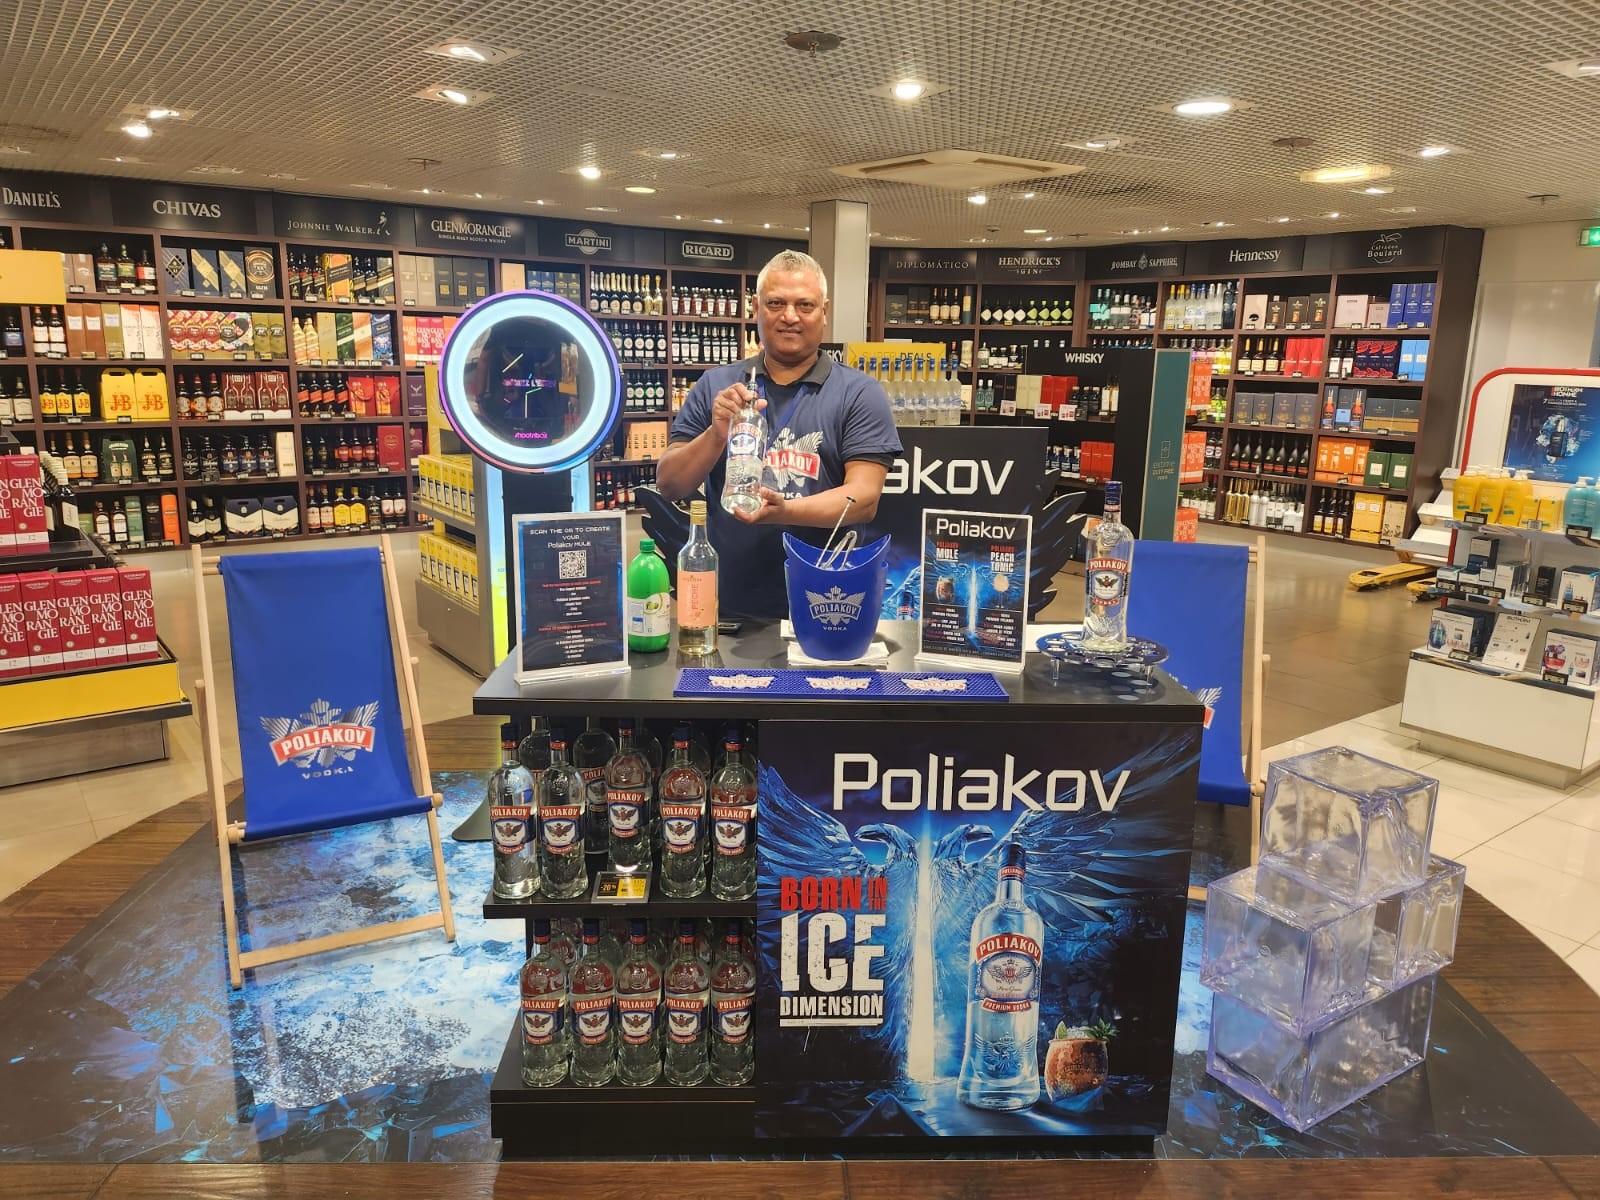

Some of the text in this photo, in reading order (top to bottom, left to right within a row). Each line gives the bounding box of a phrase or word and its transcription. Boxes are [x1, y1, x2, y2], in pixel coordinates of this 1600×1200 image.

[153, 200, 221, 218] CHIVAS
[287, 219, 331, 231] JOHNNIE
[431, 219, 512, 238] GLENMORANGIE
[567, 236, 611, 249] MARTINI
[685, 243, 731, 258] RICARD
[1229, 248, 1281, 263] Hennessy
[1367, 248, 1402, 257] Boulard
[896, 259, 969, 269] DIPLOMÁTICO
[998, 257, 1061, 266] HENDRICK'S
[1111, 260, 1137, 270] BOMBAY
[1065, 353, 1105, 364] WHISKY
[767, 451, 814, 472] LIAKOV
[881, 445, 1015, 495] akov
[10, 477, 41, 488] GLEN
[22, 487, 43, 498] MO
[12, 498, 37, 508] RAN
[23, 507, 44, 517] GIE
[936, 518, 1016, 540] Poliakov
[936, 547, 959, 560] MULE
[991, 551, 1014, 562] PEACH
[991, 561, 1014, 573] TONIC
[1090, 560, 1127, 571] POLIAKOV
[89, 593, 120, 604] GLEN
[122, 590, 152, 601] GLEN
[24, 599, 57, 612] GLEN
[57, 596, 89, 607] GLEN
[133, 598, 154, 610] MO
[69, 605, 91, 616] MO
[101, 602, 122, 613] MO
[813, 604, 857, 616] POLIAKOV
[3, 612, 25, 623] MO
[37, 609, 59, 620] MO
[91, 612, 116, 623] RAN
[124, 609, 148, 620] RAN
[26, 619, 52, 631] RAN
[60, 615, 85, 627] RAN
[102, 621, 122, 631] GIE
[134, 617, 154, 628] GIE
[38, 628, 59, 639] GIE
[71, 624, 91, 635] GIE
[4, 632, 25, 643] GIE
[281, 728, 366, 756] POLIAKOV
[302, 766, 354, 779] VODKA
[584, 769, 606, 779] POLIA
[833, 752, 1131, 812] Poliakov
[608, 792, 642, 802] POLIAKOV
[491, 808, 528, 817] POLIAKOV
[541, 808, 578, 817] POLIAKOV
[662, 807, 699, 816] POLIAKOV
[713, 808, 749, 819] POLIAKOV
[780, 876, 888, 911] BORN IN
[868, 898, 887, 911] THE
[781, 912, 887, 992] ICE
[979, 937, 1040, 957] POLIAKOV
[521, 1000, 557, 1009] POLIAKOV
[576, 997, 612, 1010] POLIAKOV
[619, 1000, 655, 1009] POLIAKOV
[666, 999, 700, 1009] POLIAKOV
[779, 994, 884, 1017] DIMENSION
[985, 1001, 1011, 1011] PREMIUM
